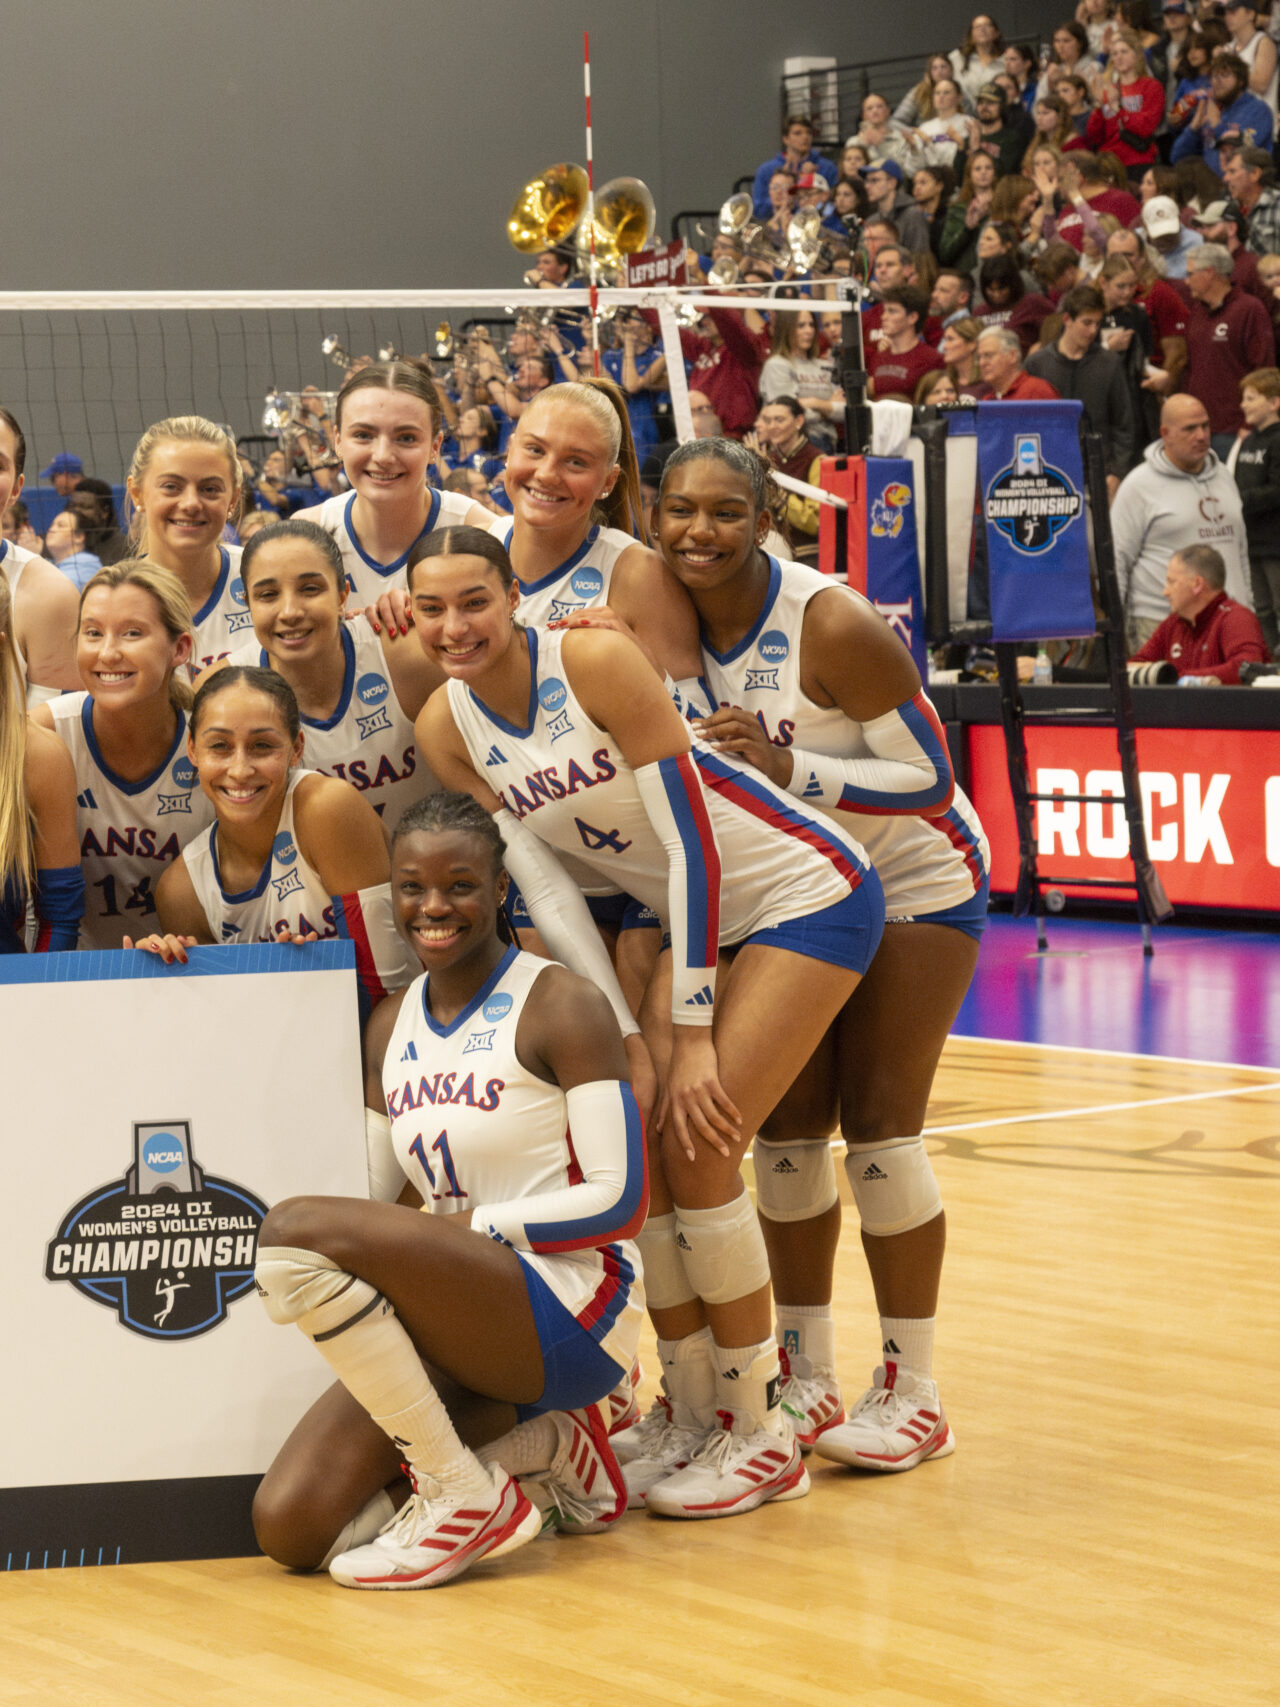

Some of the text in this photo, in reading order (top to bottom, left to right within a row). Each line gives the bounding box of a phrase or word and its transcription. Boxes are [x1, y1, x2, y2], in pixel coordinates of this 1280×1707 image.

[987, 496, 1079, 517] CHAMPIONSHIP
[761, 644, 787, 656] NCAA
[362, 683, 388, 700] NCAA
[1036, 767, 1235, 865] ROCK
[81, 826, 180, 861] ANSA
[574, 816, 632, 854] 4
[387, 1071, 506, 1126] KANSAS
[147, 1151, 184, 1164] NCAA
[408, 1129, 469, 1200] 11
[120, 1201, 213, 1219] 2024 DI
[78, 1216, 257, 1237] WOMEN'S VOLLEYBALL
[52, 1235, 255, 1275] CHAMPIONSH
